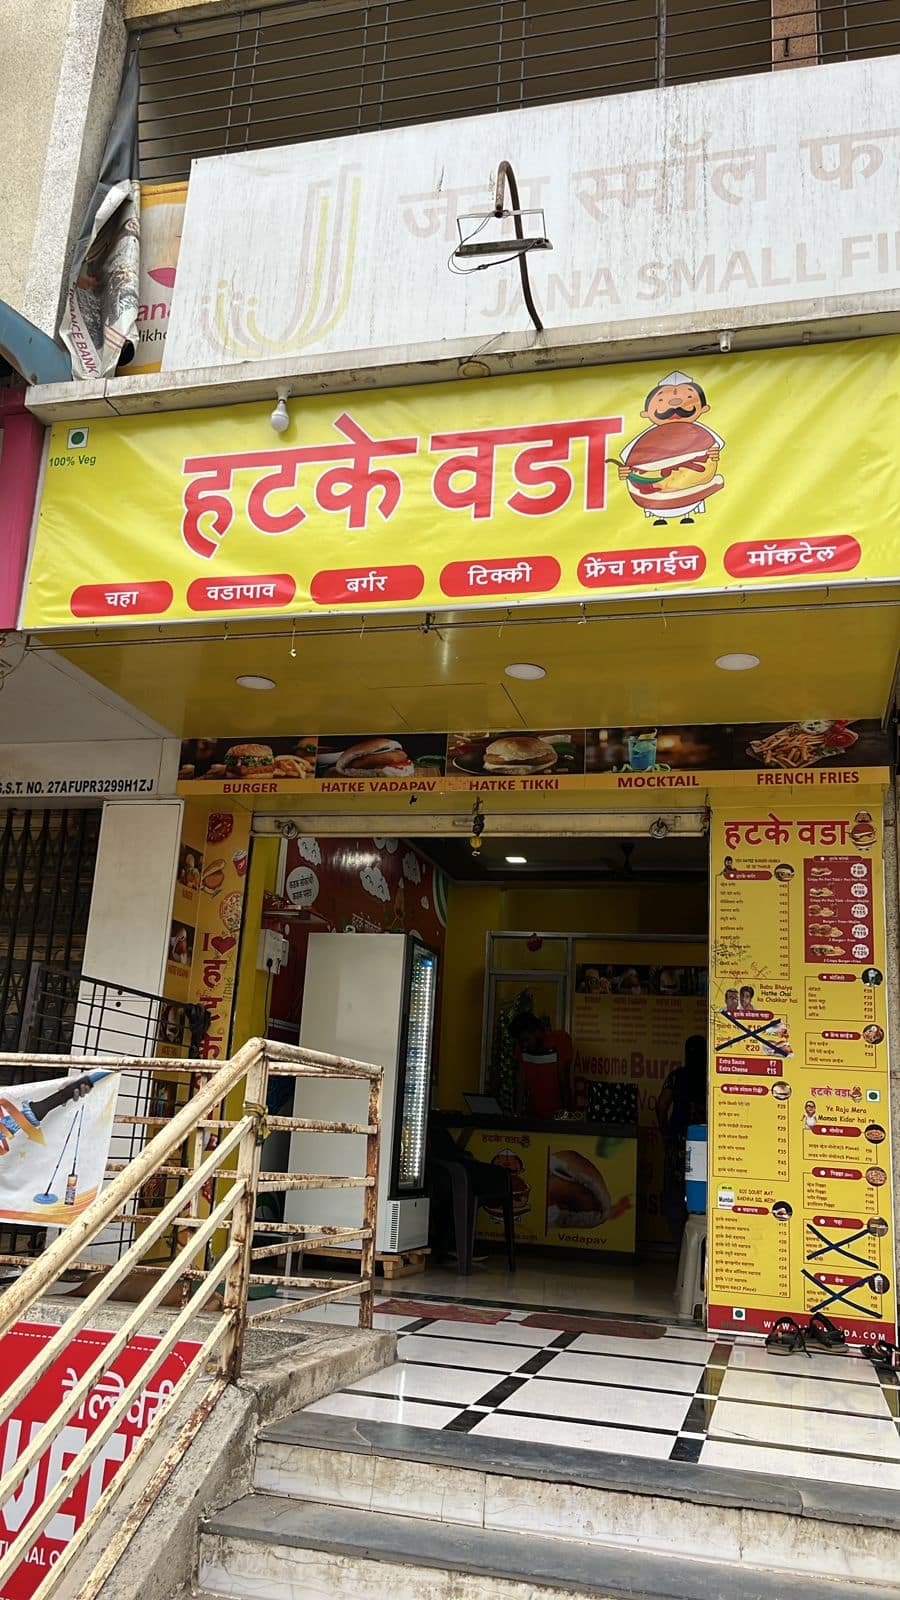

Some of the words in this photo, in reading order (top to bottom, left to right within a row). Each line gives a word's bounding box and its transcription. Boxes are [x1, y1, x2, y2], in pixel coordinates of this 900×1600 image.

[480, 266, 621, 318] JANA
[636, 241, 826, 302] SMALL
[842, 230, 900, 279] FI
[136, 302, 171, 321] an
[49, 456, 75, 467] 100%
[78, 455, 97, 466] Veg
[182, 412, 419, 559] हटके
[427, 415, 624, 521] वडा
[748, 543, 836, 566] मॉकटेल
[584, 556, 624, 580] फ्रेंच
[631, 549, 699, 576] फ्राईज
[346, 571, 388, 594] बर्गर
[467, 562, 533, 587] टिक्की
[105, 590, 139, 607] चहा
[206, 582, 277, 602] वडापाव
[26, 782, 45, 794] NO.
[47, 779, 154, 794] 27AFUPR3299H1ZJ
[321, 782, 365, 793] HATKE
[369, 781, 436, 792] VADAPAV
[469, 779, 515, 791] HATKE
[520, 778, 559, 790] TIKKI
[617, 775, 700, 788] MOCKTAIL
[757, 772, 814, 785] FRENCH
[819, 771, 859, 784] FRIES
[222, 783, 278, 793] BURGER
[724, 813, 793, 850] हटके
[797, 820, 850, 846] वडा
[574, 1049, 627, 1075] Awesome
[558, 1233, 607, 1245] Vadapav
